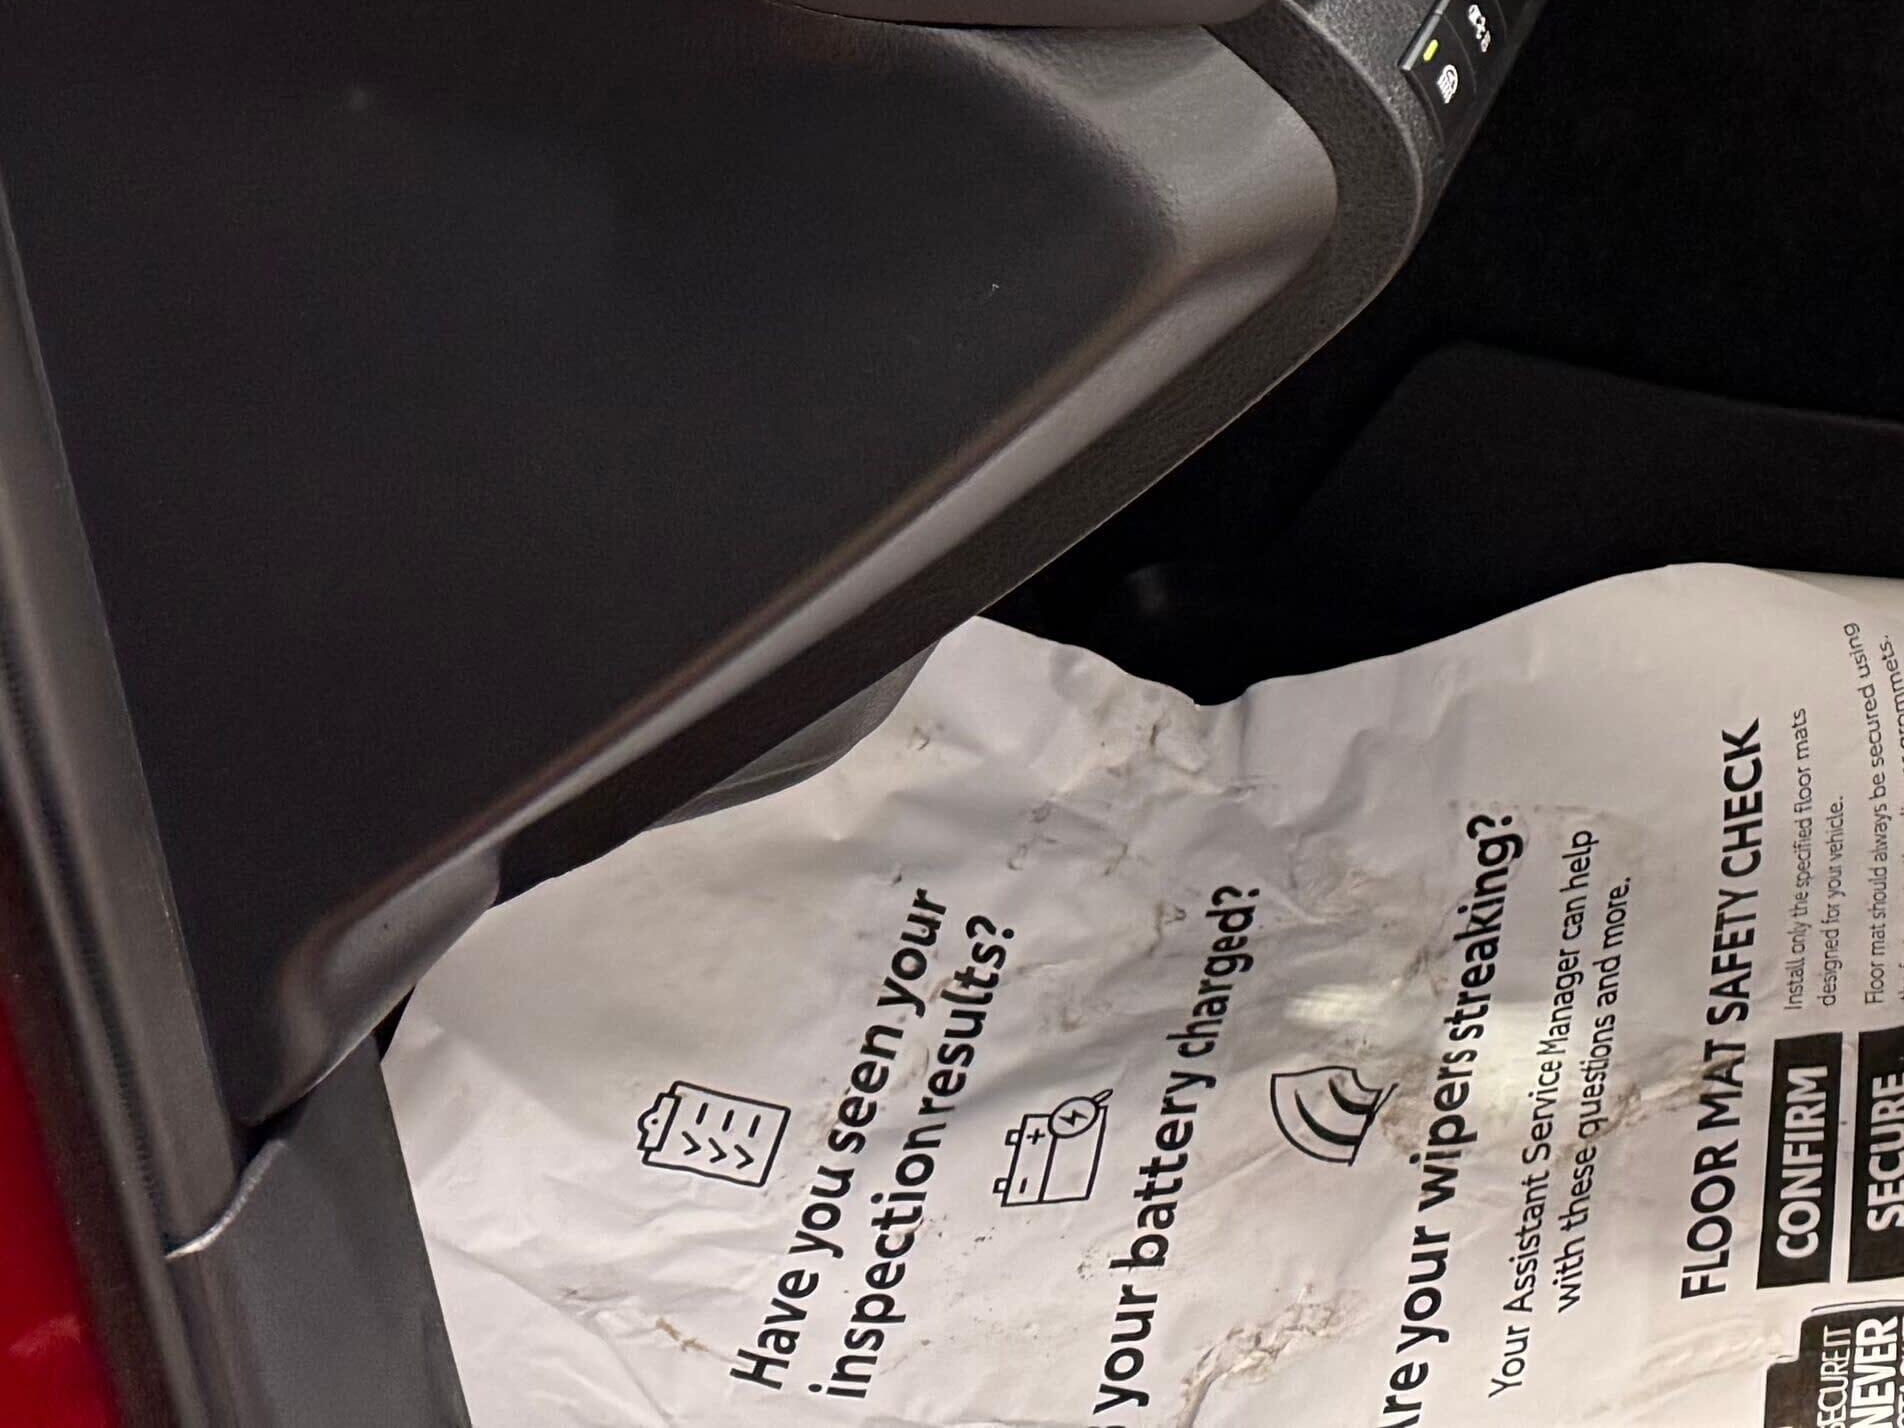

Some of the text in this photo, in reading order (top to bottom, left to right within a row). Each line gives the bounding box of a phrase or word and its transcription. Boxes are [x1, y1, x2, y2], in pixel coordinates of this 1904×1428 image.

[1784, 708, 1813, 1011] Install only the specified floor mats
[1818, 796, 1846, 1007] designed for your vehicle.
[1843, 622, 1892, 1004] Floor mat should always be secured using
[1167, 884, 1260, 1060] charged?
[1443, 813, 1525, 1047] streaking?
[1680, 718, 1763, 1298] FLOOR MAT SAFETY CHECK
[729, 888, 948, 1389] Have you seen your
[808, 914, 1016, 1400] inspection results?
[1110, 1070, 1216, 1271] battery
[1409, 1048, 1478, 1213] wipers
[1488, 829, 1600, 1398] Your Assistant Service Manager can help
[1554, 876, 1632, 1314] with these questions and more.
[1776, 1065, 1828, 1259] CONFIRM
[1093, 1284, 1158, 1415] your
[1396, 1226, 1452, 1353] your
[1850, 1316, 1899, 1428] NEVER
